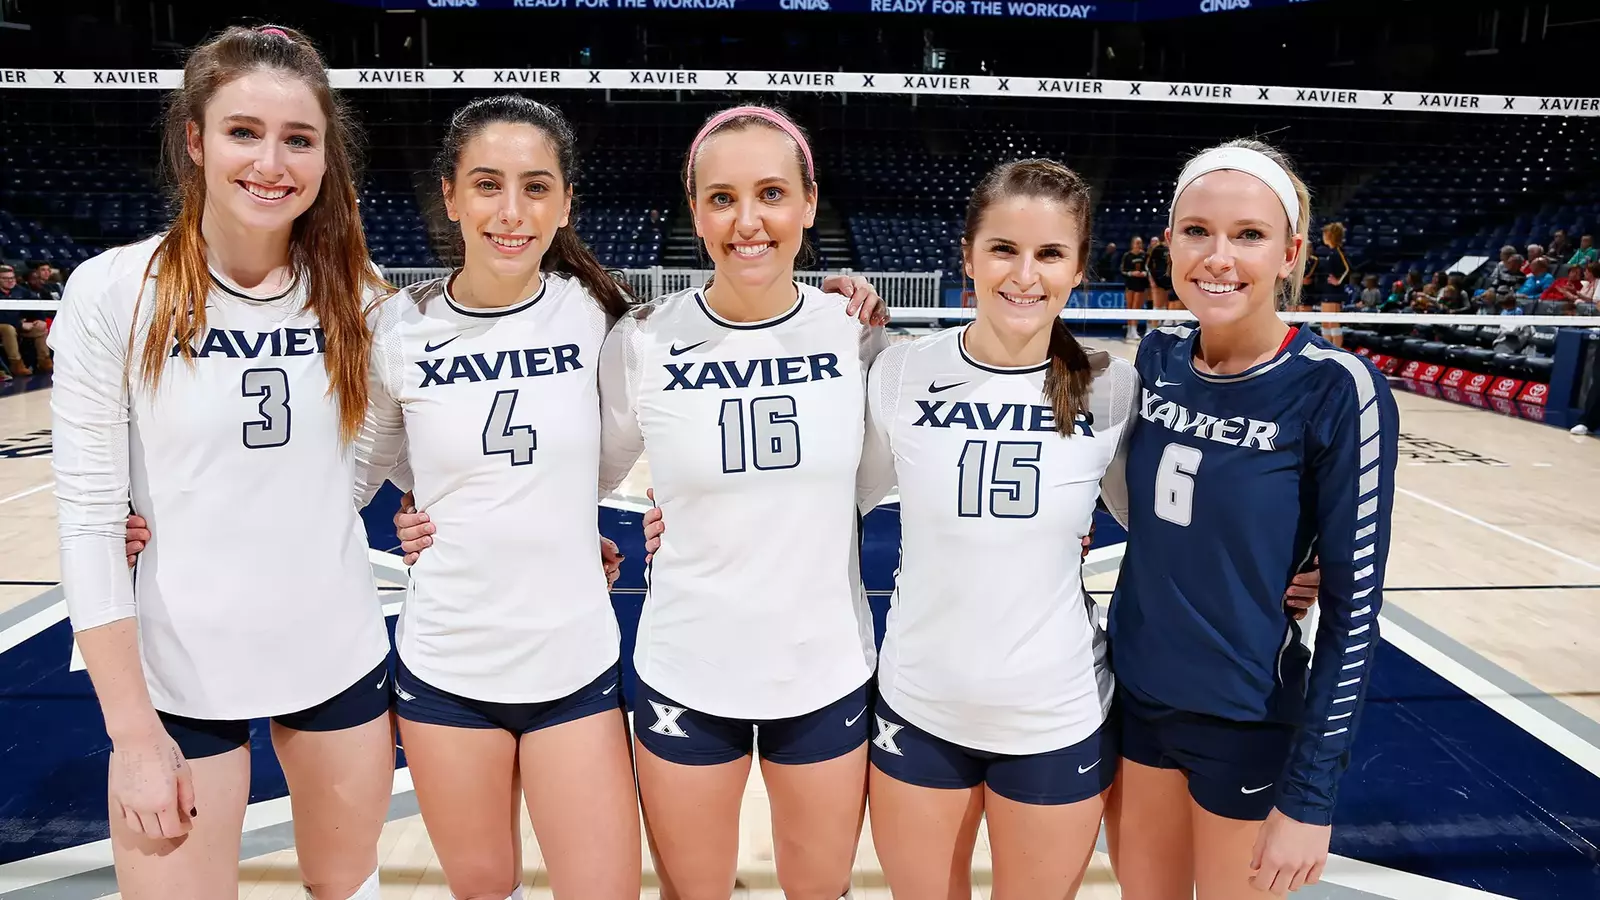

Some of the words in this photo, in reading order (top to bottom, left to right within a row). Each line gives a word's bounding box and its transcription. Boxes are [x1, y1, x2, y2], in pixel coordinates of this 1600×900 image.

[870, 0, 927, 13] READY
[932, 0, 966, 14] FOR
[970, 0, 1002, 15] THE
[1007, 2, 1091, 18] WORKDAY
[53, 71, 67, 84] X
[93, 71, 158, 84] XAVIER
[359, 70, 425, 83] XAVIER
[453, 70, 465, 83] X
[493, 70, 560, 83] XAVIER
[589, 70, 601, 84] X
[630, 71, 697, 84] XAVIER
[726, 72, 738, 85] X
[767, 73, 834, 86] XAVIER
[862, 75, 875, 87] X
[903, 76, 970, 89] XAVIER
[997, 78, 1009, 91] X
[1037, 80, 1103, 94] XAVIER
[1129, 83, 1141, 96] X
[1168, 85, 1232, 98] XAVIER
[1257, 88, 1270, 100] X
[1296, 90, 1357, 103] XAVIER
[1382, 93, 1394, 105] X
[1418, 95, 1480, 109] XAVIER
[1503, 97, 1515, 110] X
[1539, 98, 1600, 111] XAVIER
[415, 343, 584, 388] XAVIER
[662, 352, 843, 391] XAVIER
[241, 367, 292, 450] 3
[481, 389, 537, 467] 4
[717, 394, 801, 474] 16
[1139, 387, 1280, 451] XAVIER
[957, 439, 1042, 518] 15
[1154, 441, 1203, 528] 6
